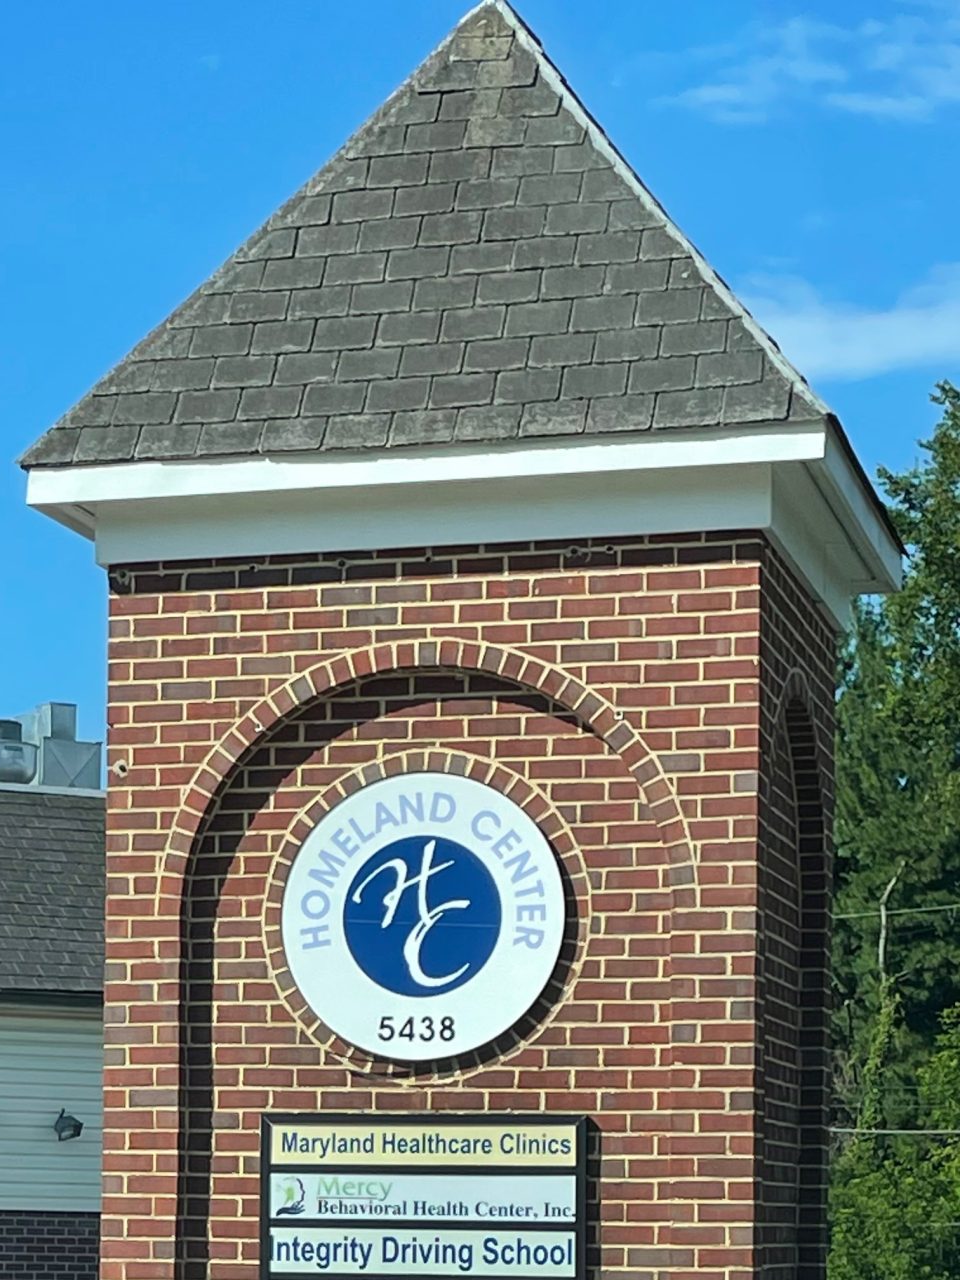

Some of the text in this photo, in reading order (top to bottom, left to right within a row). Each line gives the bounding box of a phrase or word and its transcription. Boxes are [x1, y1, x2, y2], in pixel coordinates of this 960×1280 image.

[300, 792, 546, 950] HOMELAND CENTER
[377, 1016, 456, 1042] 5438
[281, 1132, 572, 1158] Maryland Healthcare Clinics
[316, 1178, 393, 1200] Mercy
[316, 1200, 576, 1219] Behavioral Health Center, Inc.
[270, 1235, 573, 1271] Integrity Driving School
